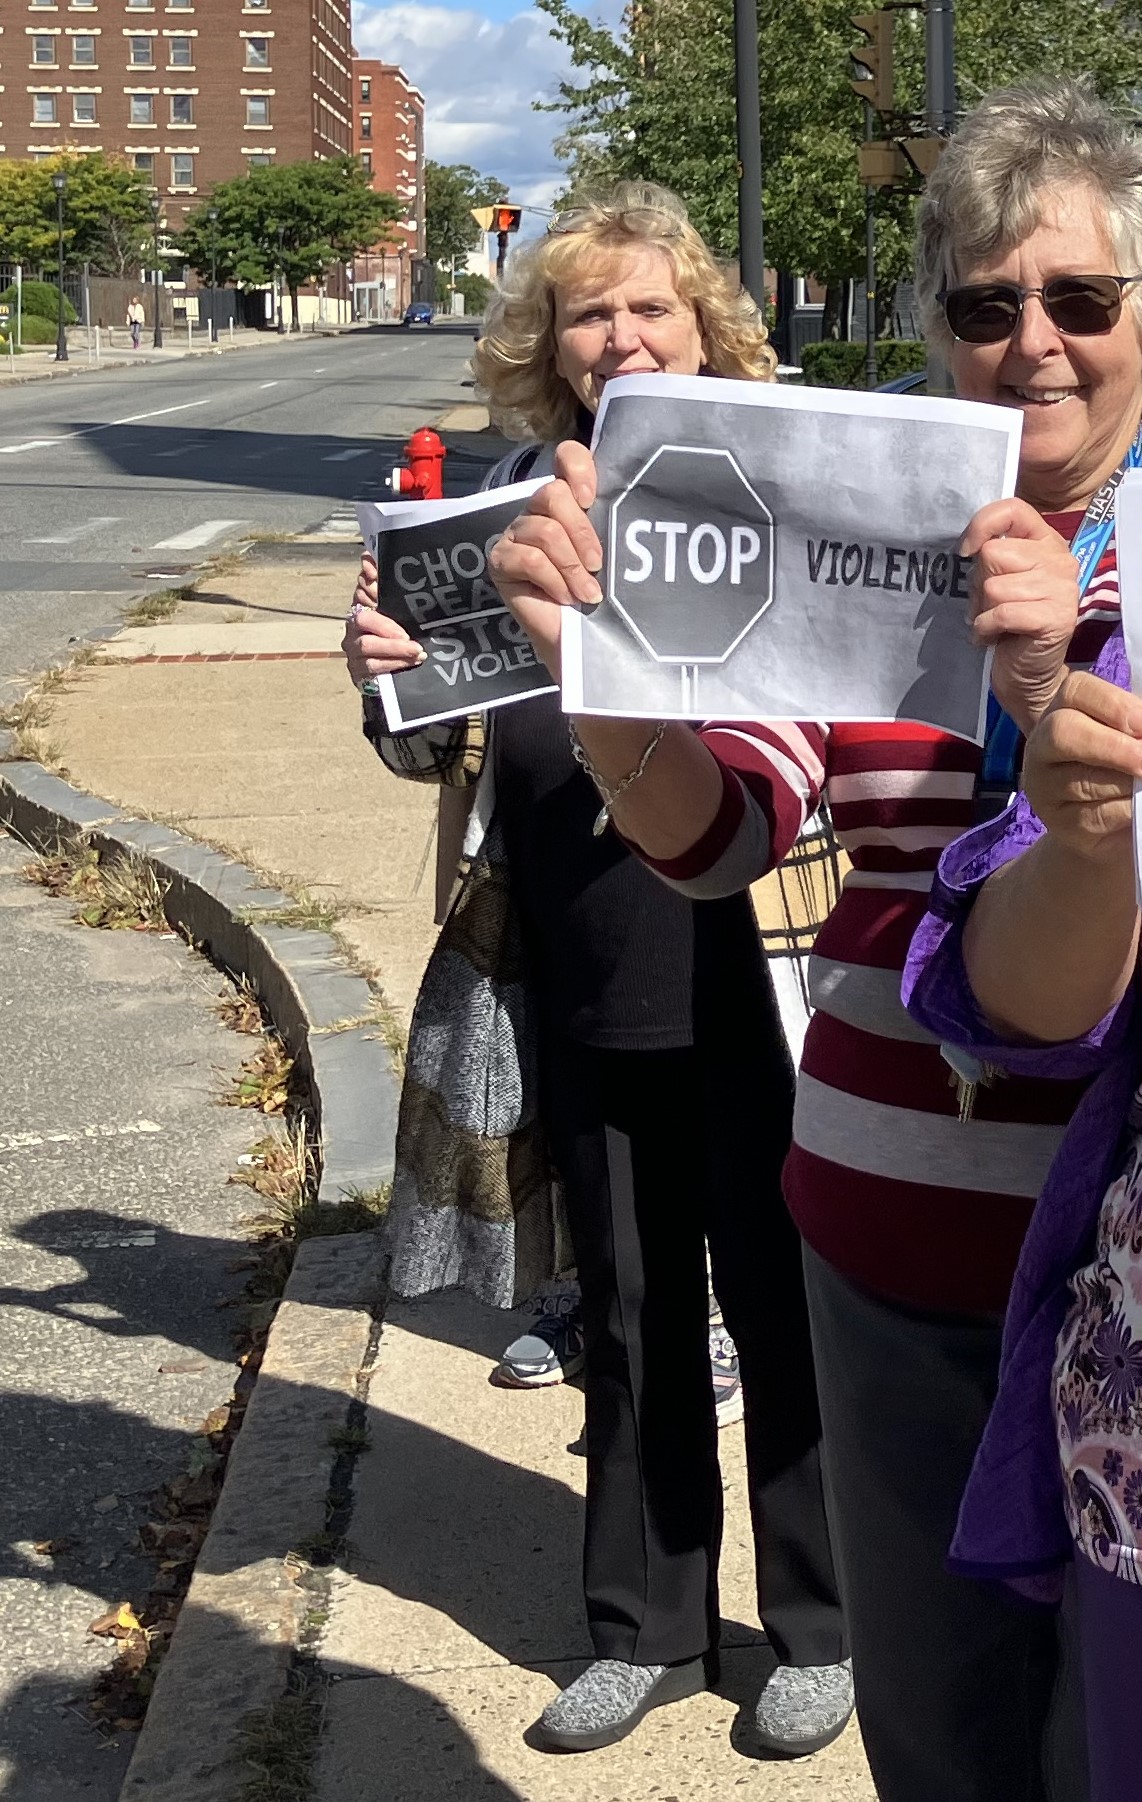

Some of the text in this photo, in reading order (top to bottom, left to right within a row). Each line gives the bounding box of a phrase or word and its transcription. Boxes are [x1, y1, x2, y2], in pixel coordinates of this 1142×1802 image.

[393, 533, 504, 591] CHO
[623, 518, 972, 599] STOP VIOLENCE
[404, 579, 499, 623] PEA
[430, 614, 529, 662] STO
[433, 643, 545, 686] VIOLE
